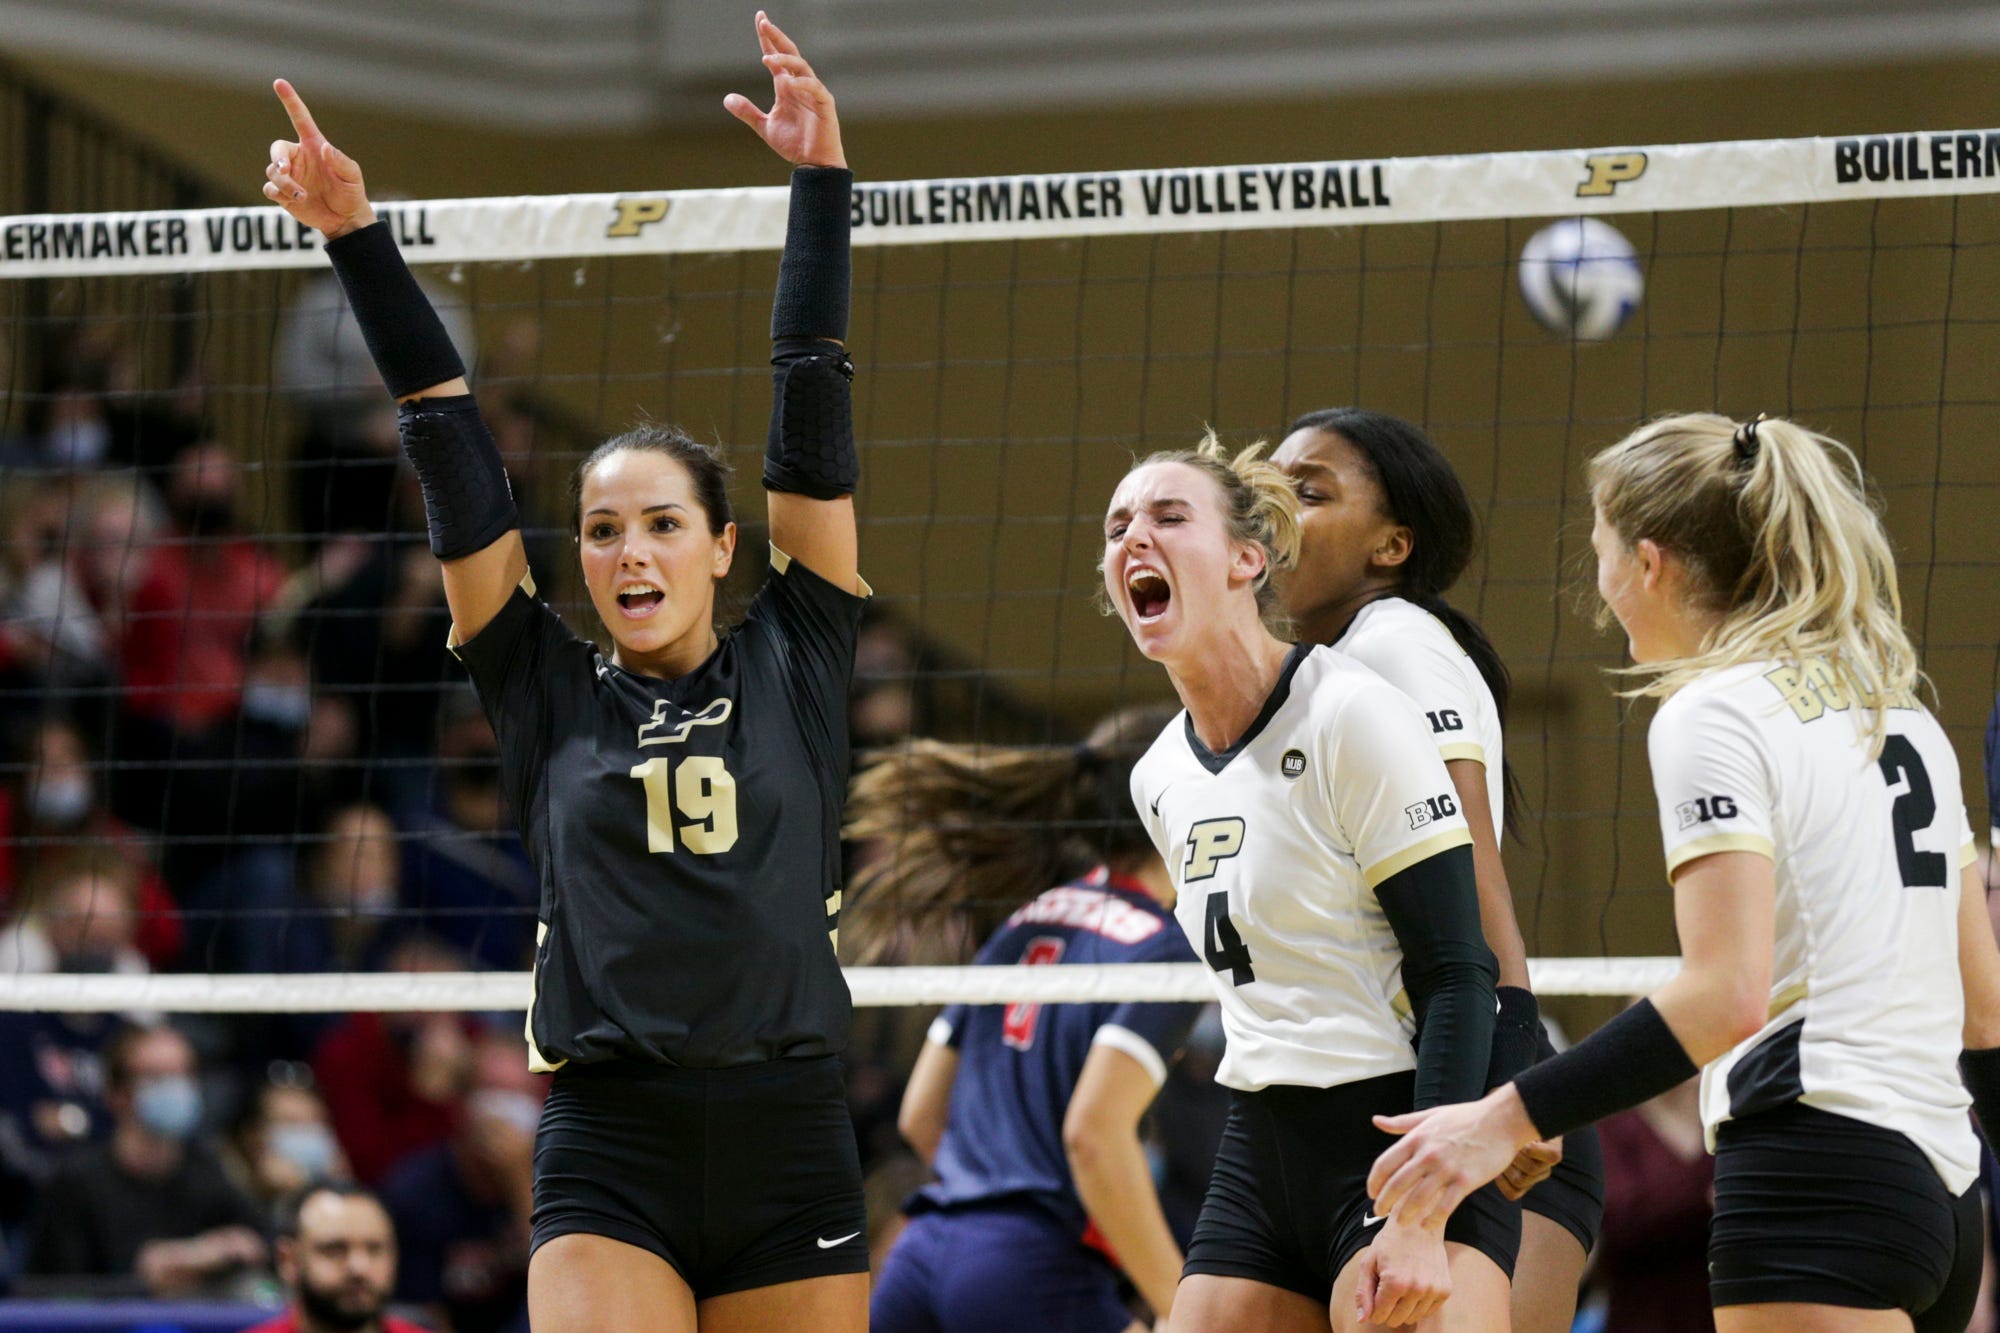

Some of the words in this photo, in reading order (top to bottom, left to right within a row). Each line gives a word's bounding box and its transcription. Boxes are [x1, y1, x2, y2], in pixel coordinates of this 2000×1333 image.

[851, 177, 1123, 227] BOILERMAKER
[1141, 164, 1391, 215] VOLLEYBALL
[0, 218, 188, 260] ERMAKER
[629, 755, 739, 855] 19
[1877, 733, 1947, 889] 2
[1184, 816, 1246, 884] P
[1204, 890, 1255, 987] 4
